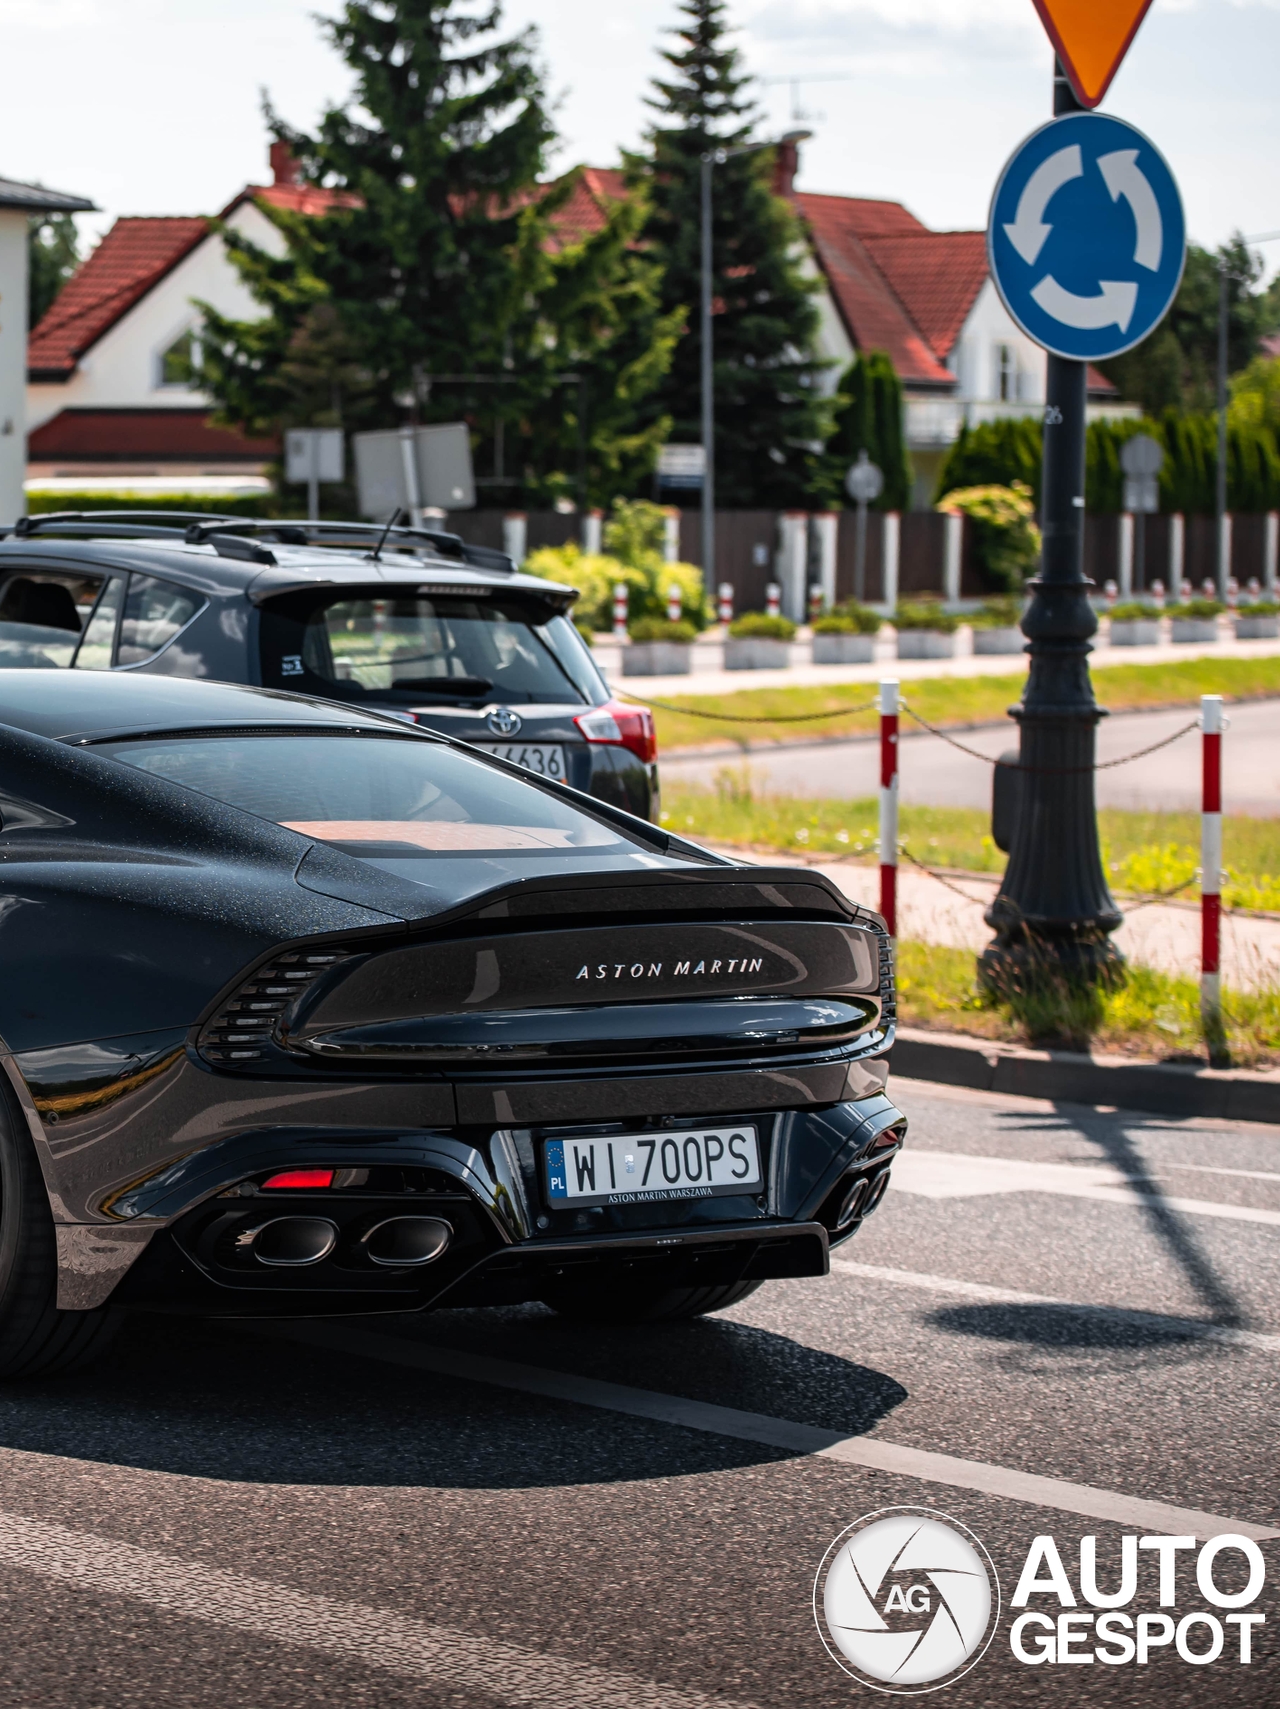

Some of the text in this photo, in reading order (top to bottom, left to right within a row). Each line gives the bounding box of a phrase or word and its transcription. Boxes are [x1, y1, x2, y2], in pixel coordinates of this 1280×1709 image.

[576, 958, 763, 980] ASTON MARTIN
[636, 1133, 750, 1186] 700PS
[551, 1177, 565, 1190] PL
[608, 1187, 713, 1204] ASTON MARTIN WARSZAWA
